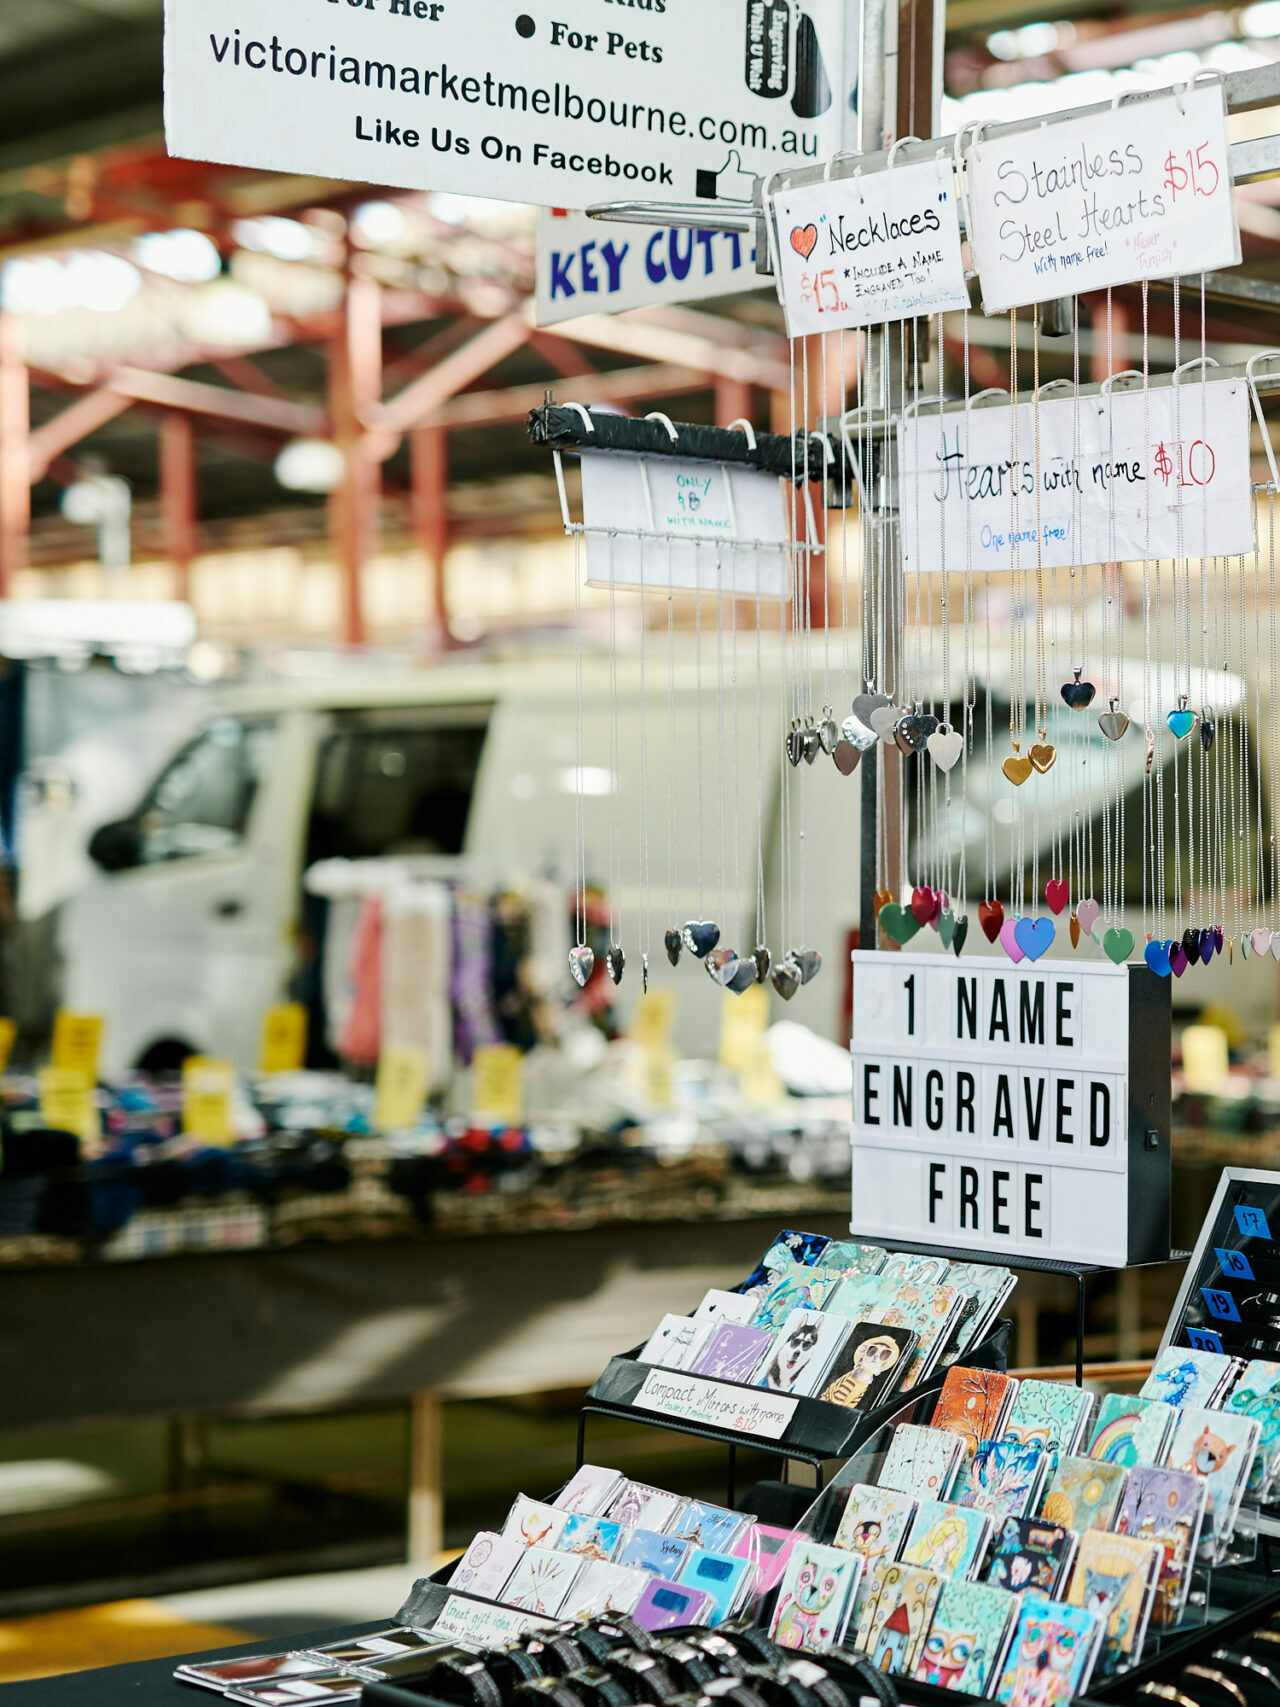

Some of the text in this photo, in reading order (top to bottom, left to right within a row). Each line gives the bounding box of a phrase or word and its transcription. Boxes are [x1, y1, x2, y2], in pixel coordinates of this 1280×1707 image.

[550, 21, 663, 63] For Pets
[209, 29, 817, 157] victoriamarketmelbourne.com.au
[355, 116, 673, 185] Like Us On Facebook
[994, 140, 1220, 207] Stainless $15
[1000, 190, 1166, 262] Steel Hearts
[551, 239, 629, 300] KEY
[1060, 251, 1084, 268] name
[934, 424, 1215, 501] Hearts with name $10
[980, 523, 1004, 552] One
[1008, 529, 1037, 544] name
[904, 974, 1074, 1047] 1 NAME
[864, 1064, 1111, 1148] ENGRAVED
[929, 1163, 1043, 1238] FREE
[1242, 1211, 1259, 1231] 17
[1211, 1293, 1230, 1314] 19
[644, 1374, 696, 1402] Compact
[735, 1415, 757, 1431] $10
